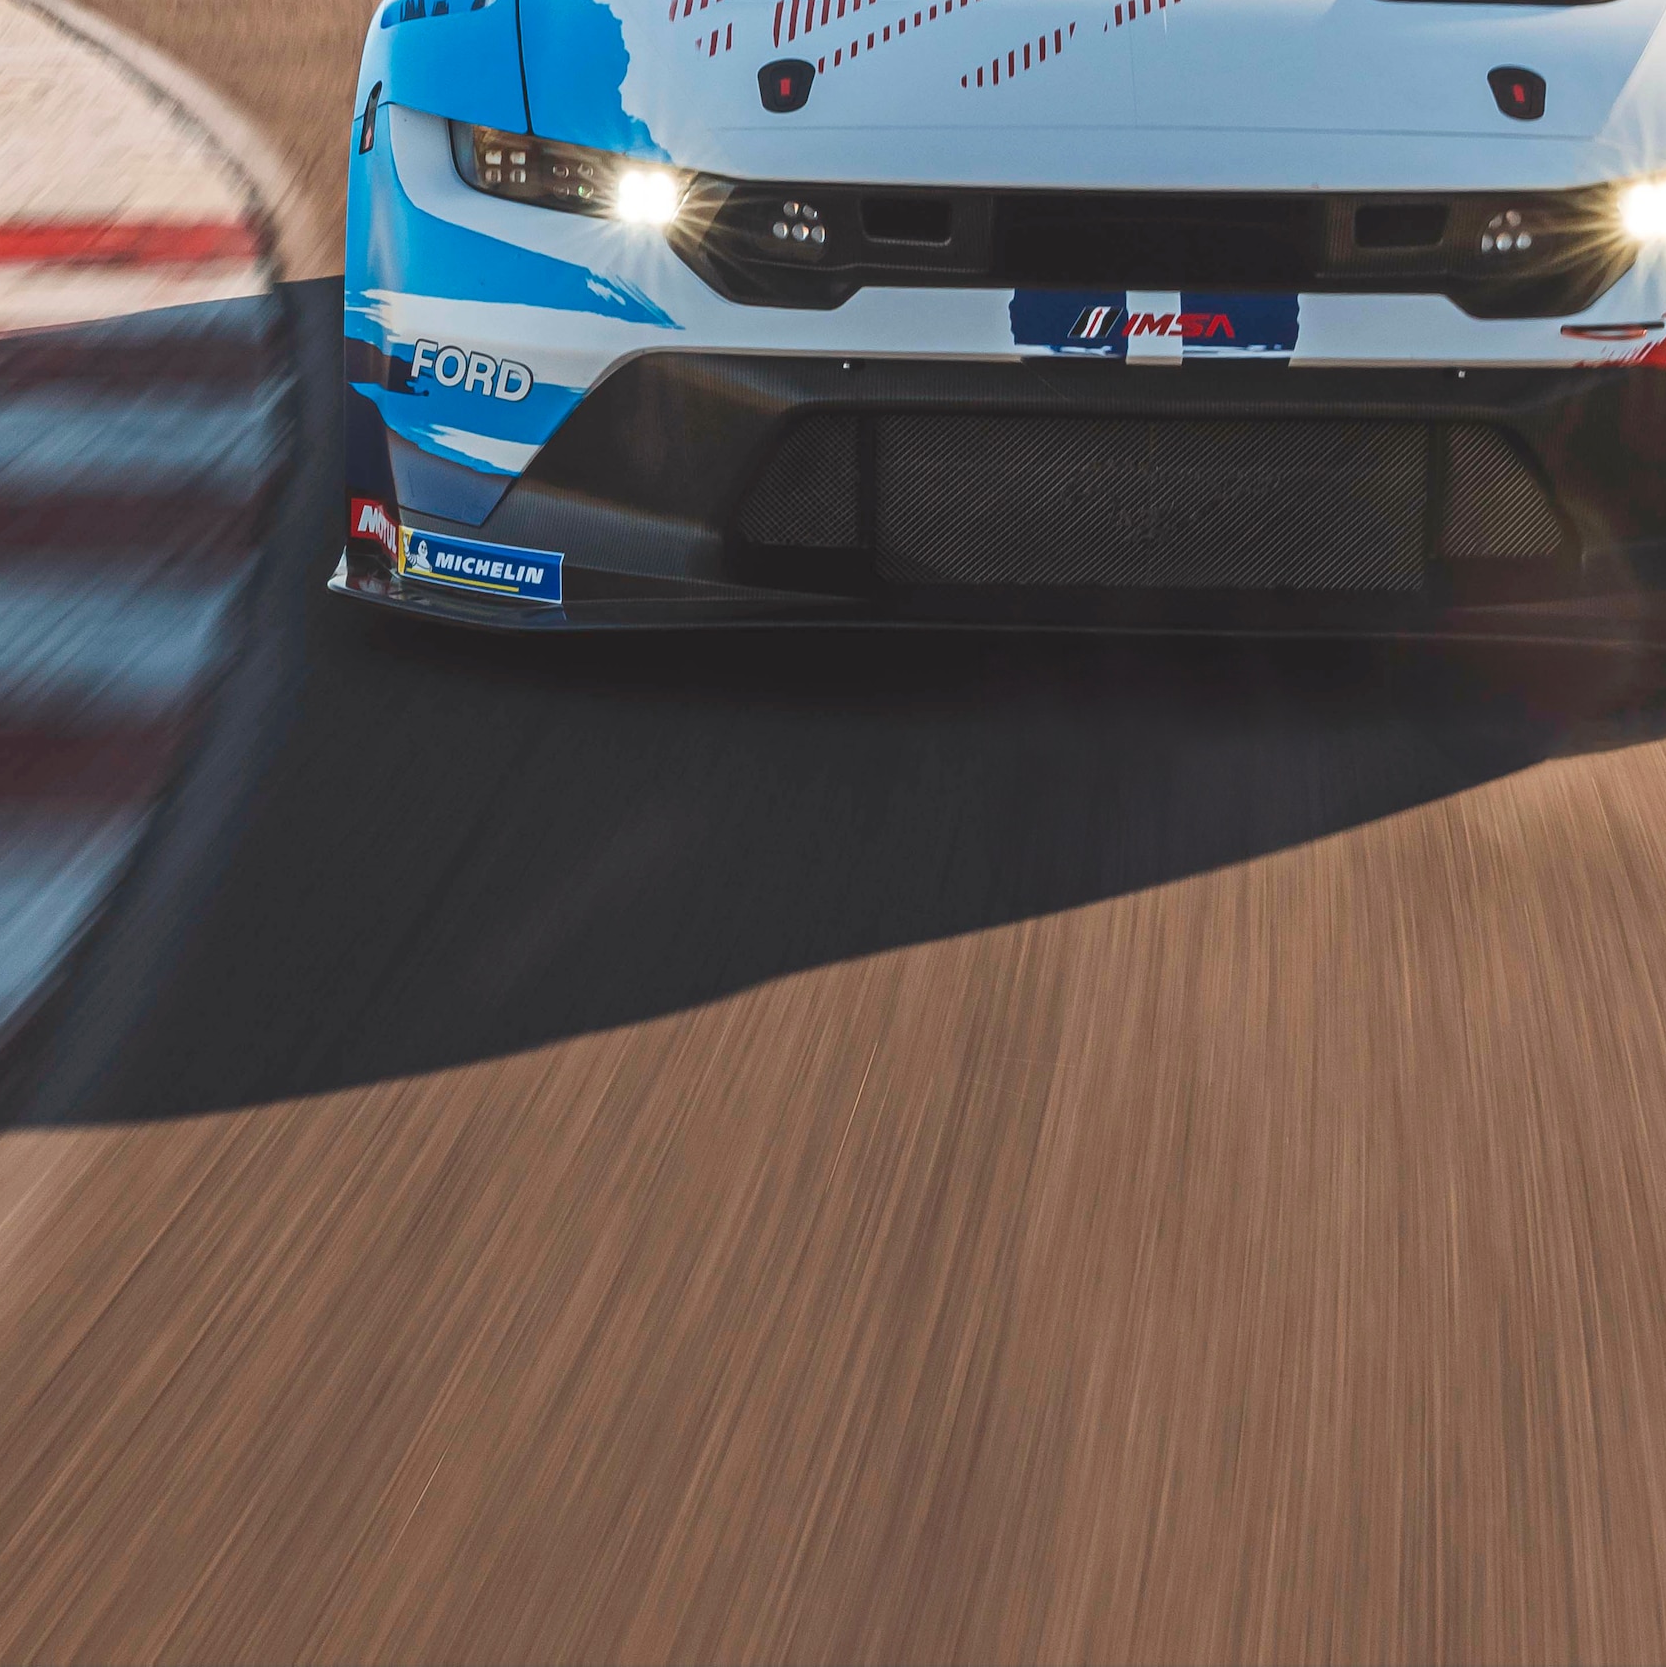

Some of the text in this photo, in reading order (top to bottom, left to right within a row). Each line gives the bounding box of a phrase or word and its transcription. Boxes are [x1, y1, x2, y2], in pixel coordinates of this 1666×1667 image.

[1122, 313, 1235, 338] IMSA
[411, 338, 533, 402] FORD
[357, 504, 397, 554] MOTUL
[435, 551, 545, 584] MICHELIN
